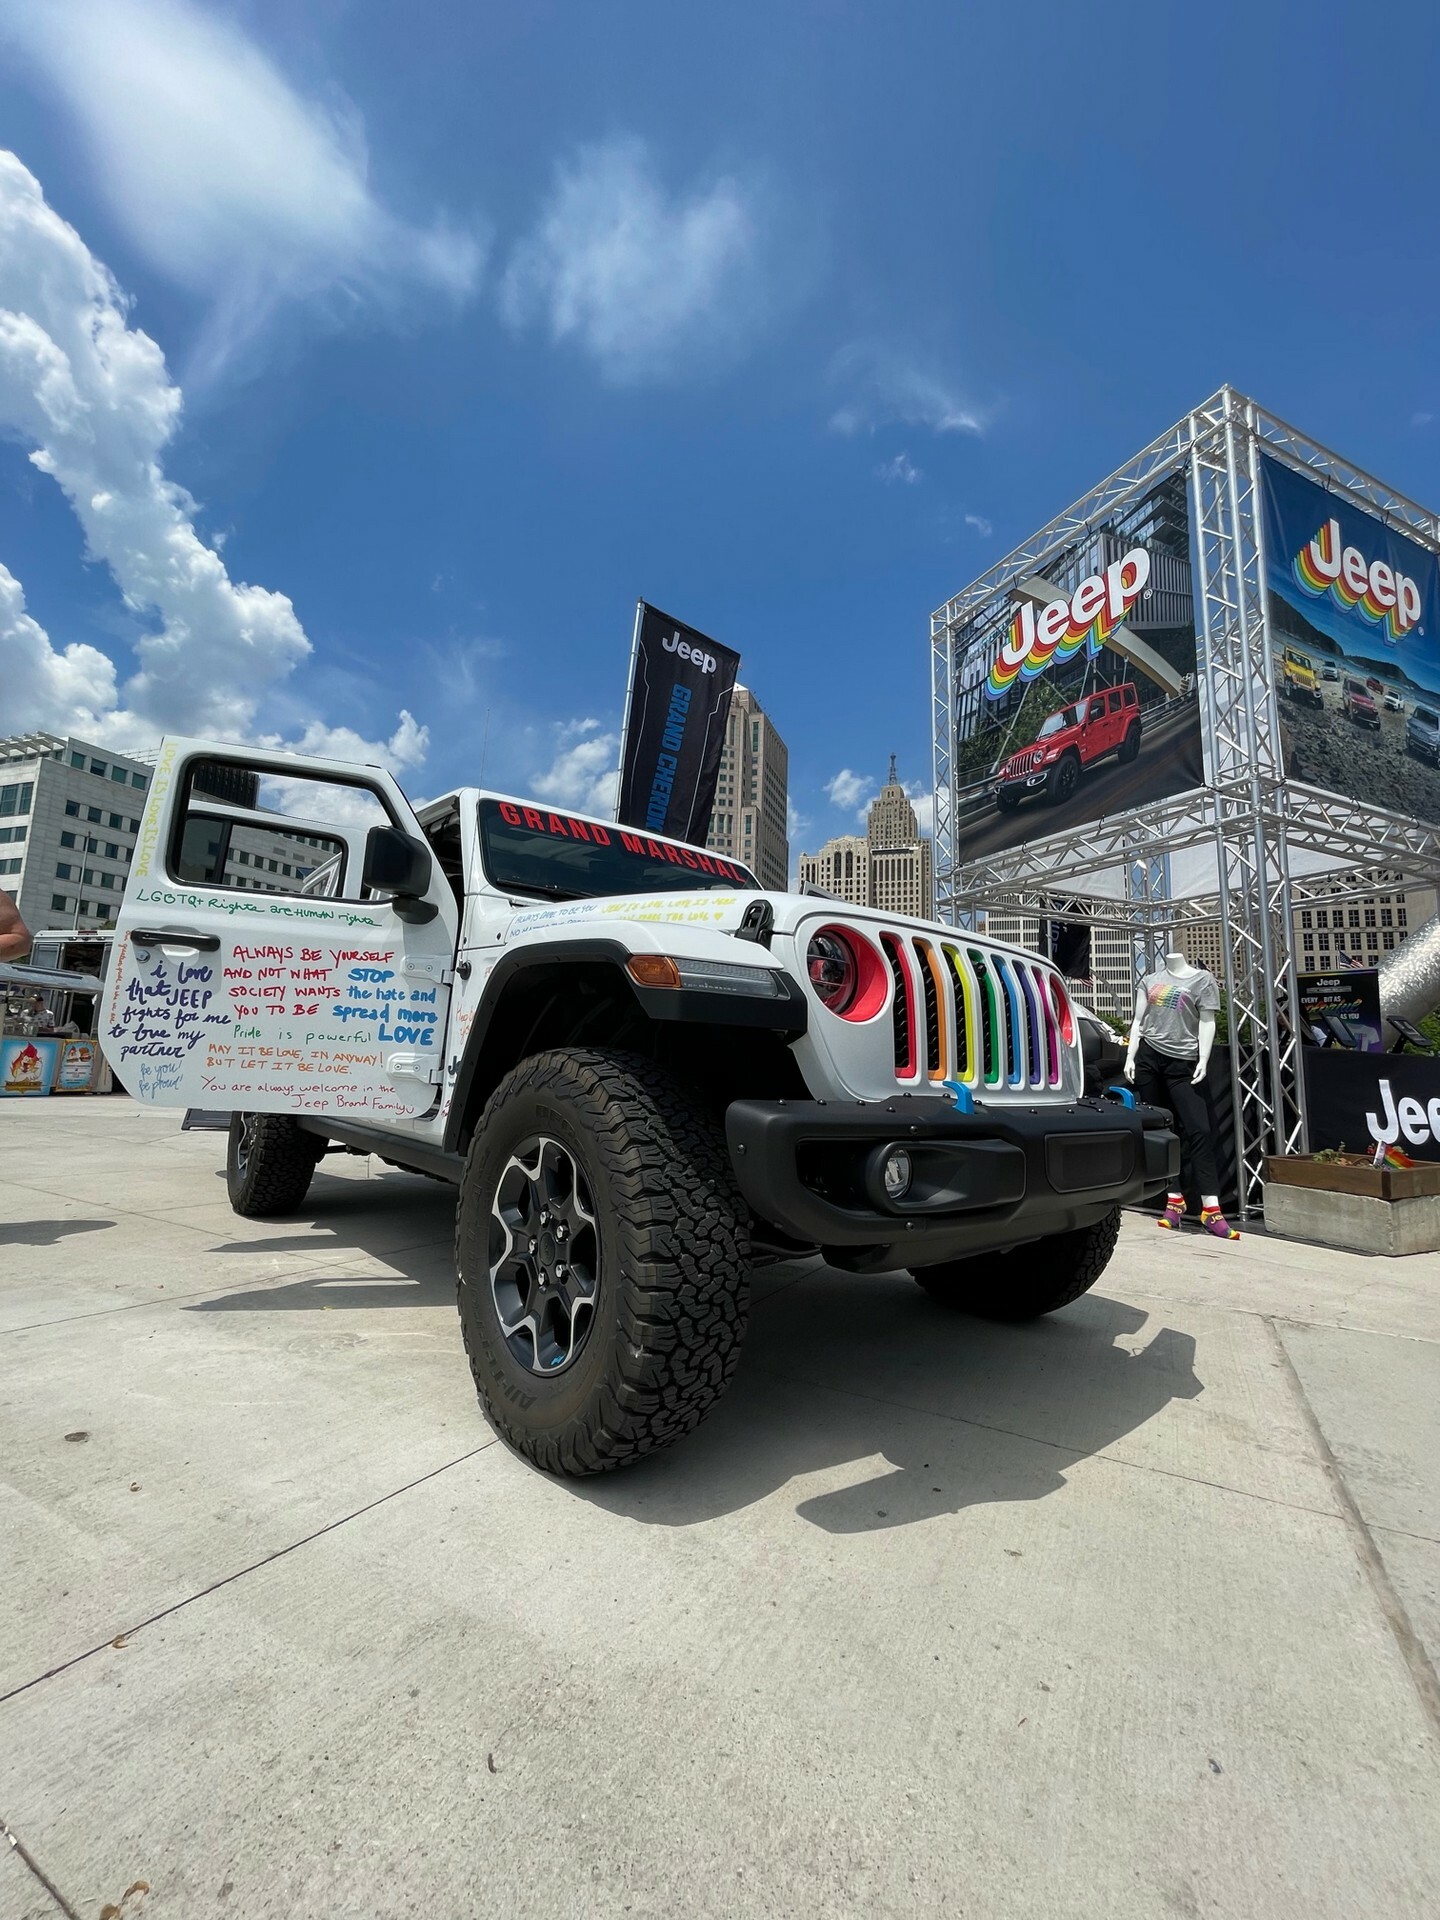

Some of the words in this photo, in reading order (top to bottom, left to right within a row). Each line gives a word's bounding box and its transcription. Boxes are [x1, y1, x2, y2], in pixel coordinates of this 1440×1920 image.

[1310, 518, 1421, 627] Jeep
[1002, 548, 1151, 666] Jeep
[662, 631, 717, 674] Jeep
[661, 682, 692, 751] GRAND
[159, 742, 178, 775] LOVE
[646, 752, 678, 833] CHEROK
[498, 802, 611, 846] GRAND
[620, 832, 747, 883] MARSHAL
[135, 843, 154, 876] LOVE
[136, 889, 204, 907] LGBTQ+
[233, 945, 293, 964] ALWAYS
[300, 948, 322, 961] BE
[330, 949, 394, 968] YOURSELF
[177, 962, 213, 984] love
[224, 967, 252, 979] AND
[258, 967, 286, 980] NOT
[290, 968, 332, 981] WHAT
[348, 968, 395, 983] STOP
[125, 978, 172, 1006] that
[166, 988, 213, 1009] JEEP
[228, 986, 286, 1001] SOCIETY
[295, 986, 340, 998] WANTS
[346, 985, 372, 1000] the
[376, 987, 405, 1001] hate
[410, 987, 436, 1003] and
[122, 1006, 171, 1024] fights
[174, 1009, 199, 1029] for
[202, 1014, 231, 1025] me
[234, 1004, 258, 1020] YOU
[265, 1005, 285, 1015] TO
[292, 1004, 319, 1016] BE
[332, 1003, 390, 1023] spread
[397, 1008, 438, 1023] more
[108, 1024, 129, 1038] to
[177, 1030, 206, 1050] my
[233, 1025, 262, 1040] Pride
[278, 1027, 293, 1040] is
[305, 1030, 371, 1045] powerful
[378, 1023, 435, 1046] LOVE
[121, 1042, 185, 1062] partner
[208, 1043, 232, 1055] MAY
[237, 1046, 255, 1056] IT
[258, 1047, 274, 1057] BE
[310, 1051, 329, 1060] IN
[206, 1057, 235, 1068] BUT
[240, 1060, 268, 1070] LET
[271, 1062, 294, 1071] IT
[298, 1062, 314, 1072] BE
[201, 1075, 226, 1092] You
[231, 1083, 252, 1092] are
[257, 1082, 295, 1096] always
[299, 1083, 358, 1093] welcome
[363, 1084, 374, 1093] in
[379, 1084, 396, 1093] the
[291, 1094, 329, 1111] Jeep
[336, 1094, 368, 1108] Brand
[372, 1097, 408, 1115] Family
[1365, 1079, 1440, 1145] Je
[1167, 1205, 1182, 1214] eep
[1211, 1215, 1224, 1224] Je
